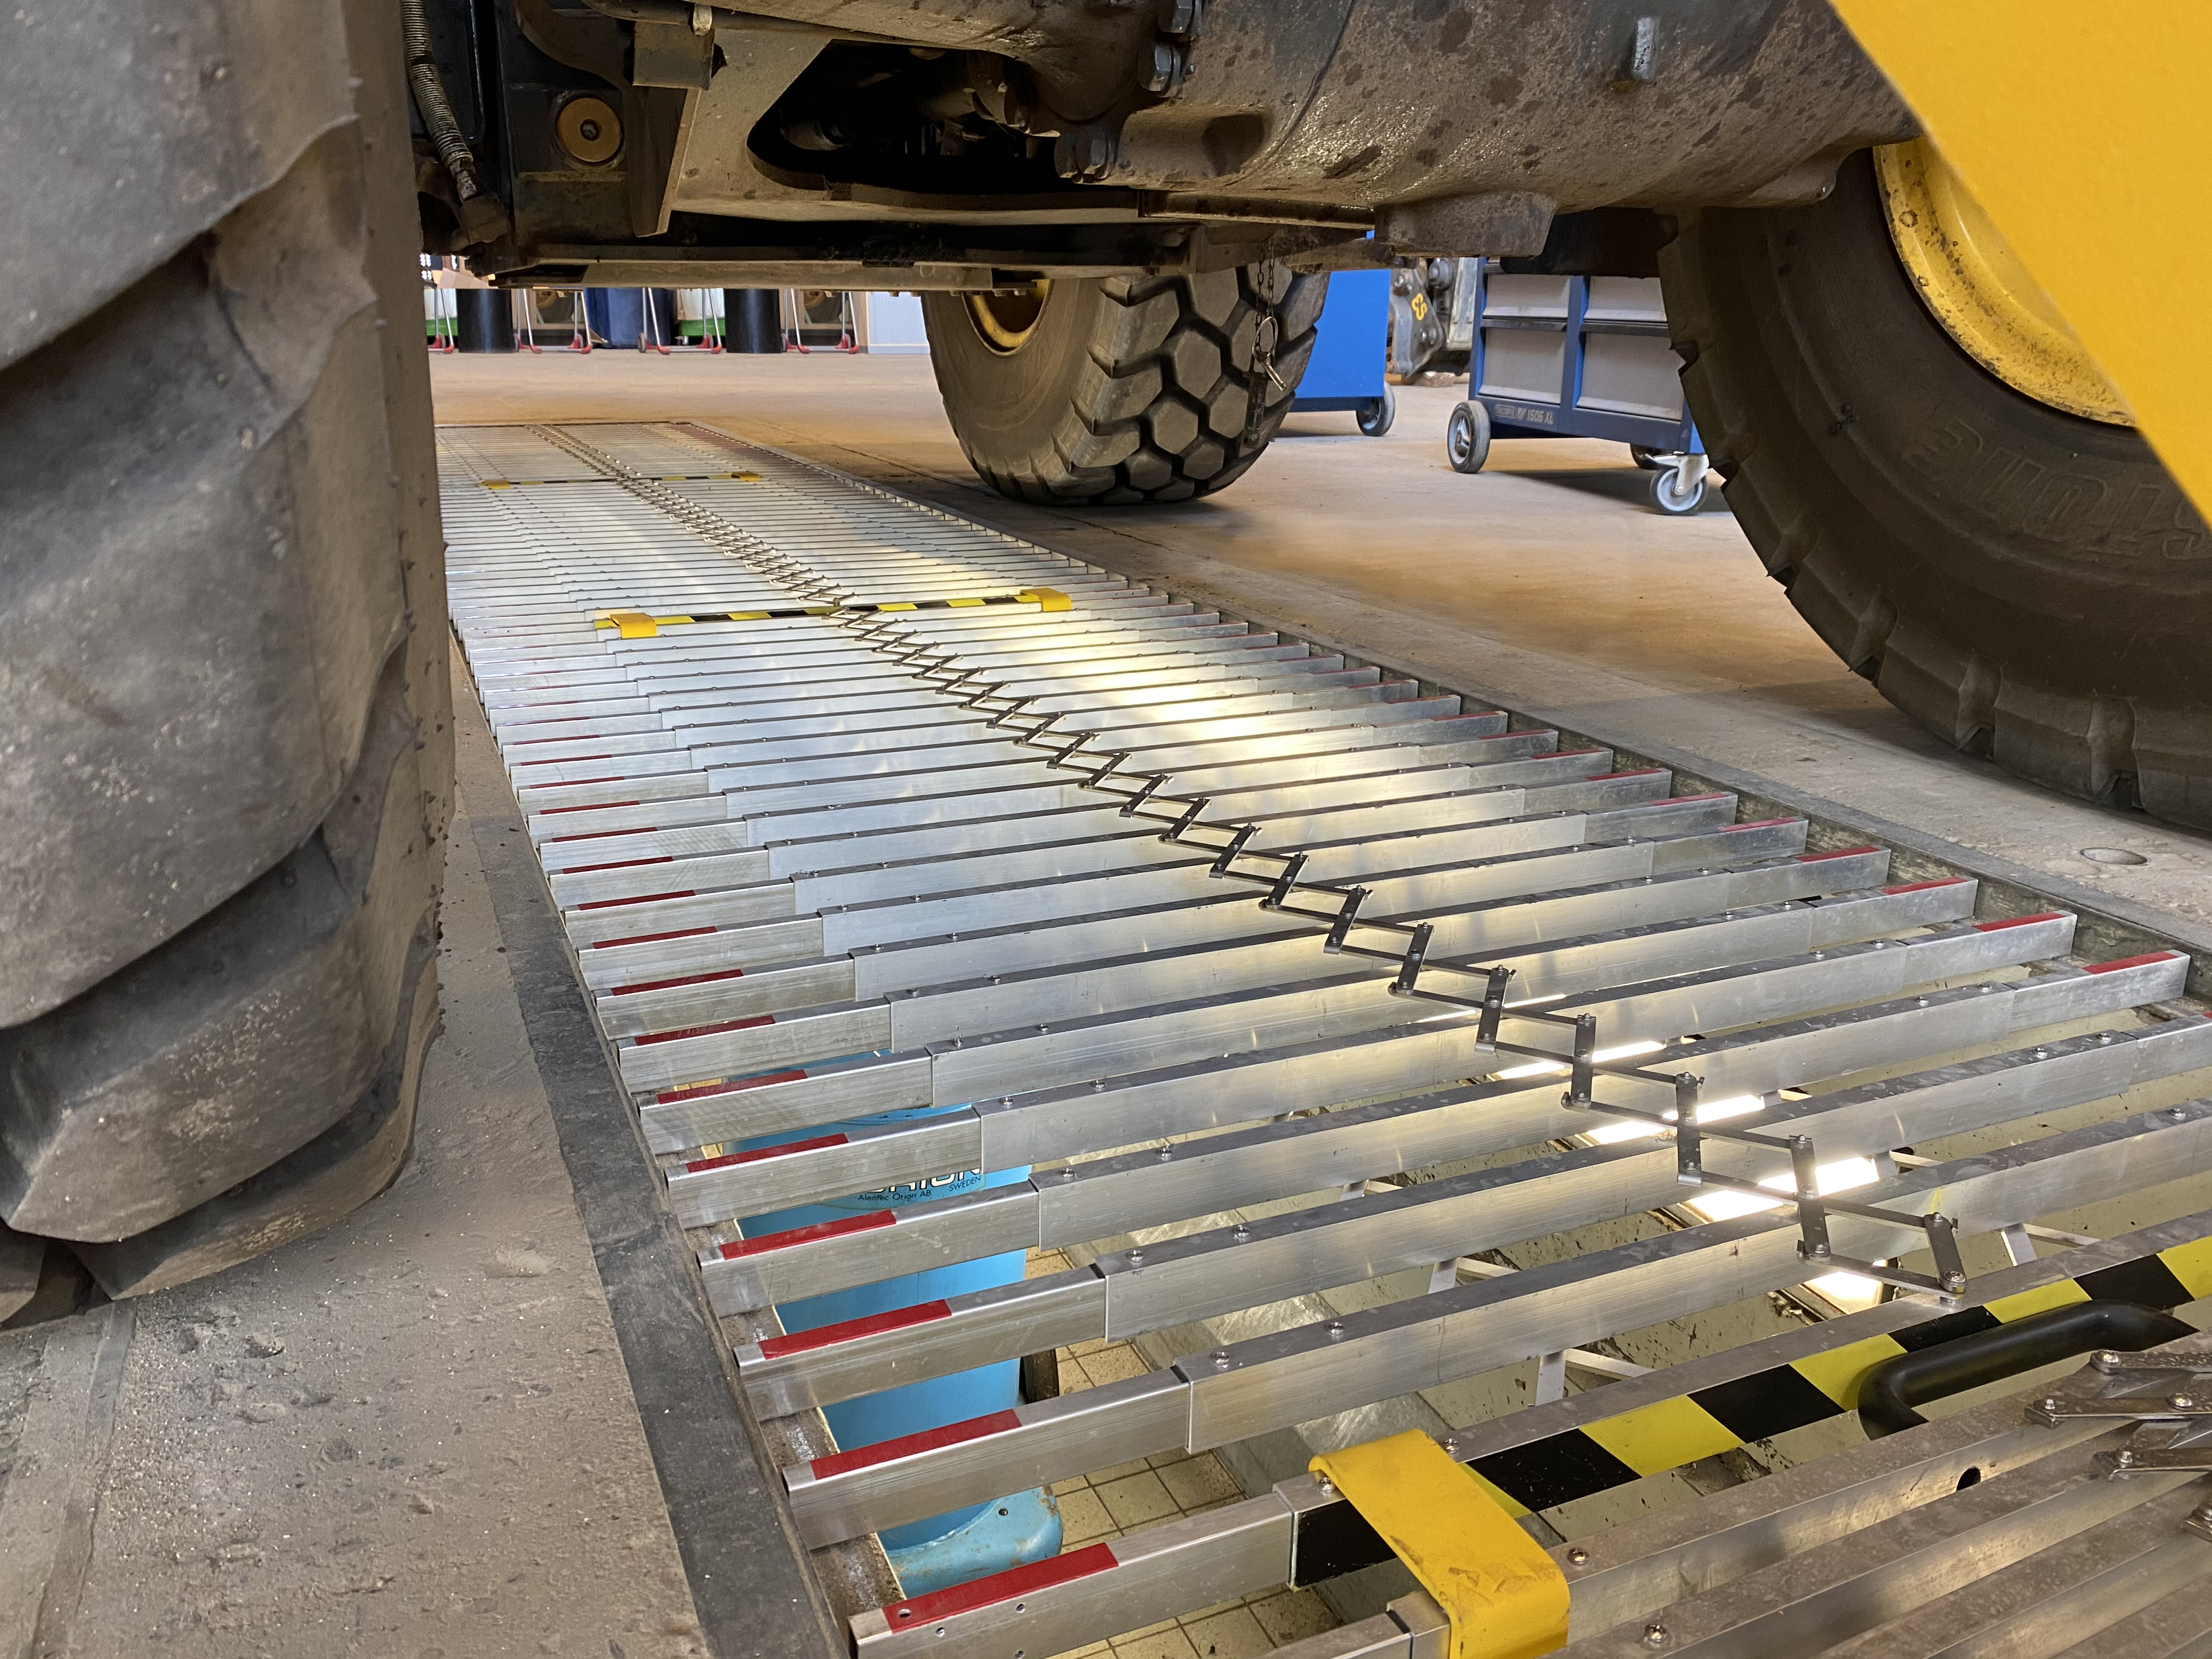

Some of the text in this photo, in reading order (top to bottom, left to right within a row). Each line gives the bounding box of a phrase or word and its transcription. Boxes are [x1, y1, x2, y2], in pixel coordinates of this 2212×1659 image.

[1544, 411, 1554, 424] XL
[949, 1174, 981, 1192] SWEDEN
[892, 1193, 917, 1201] Orion
